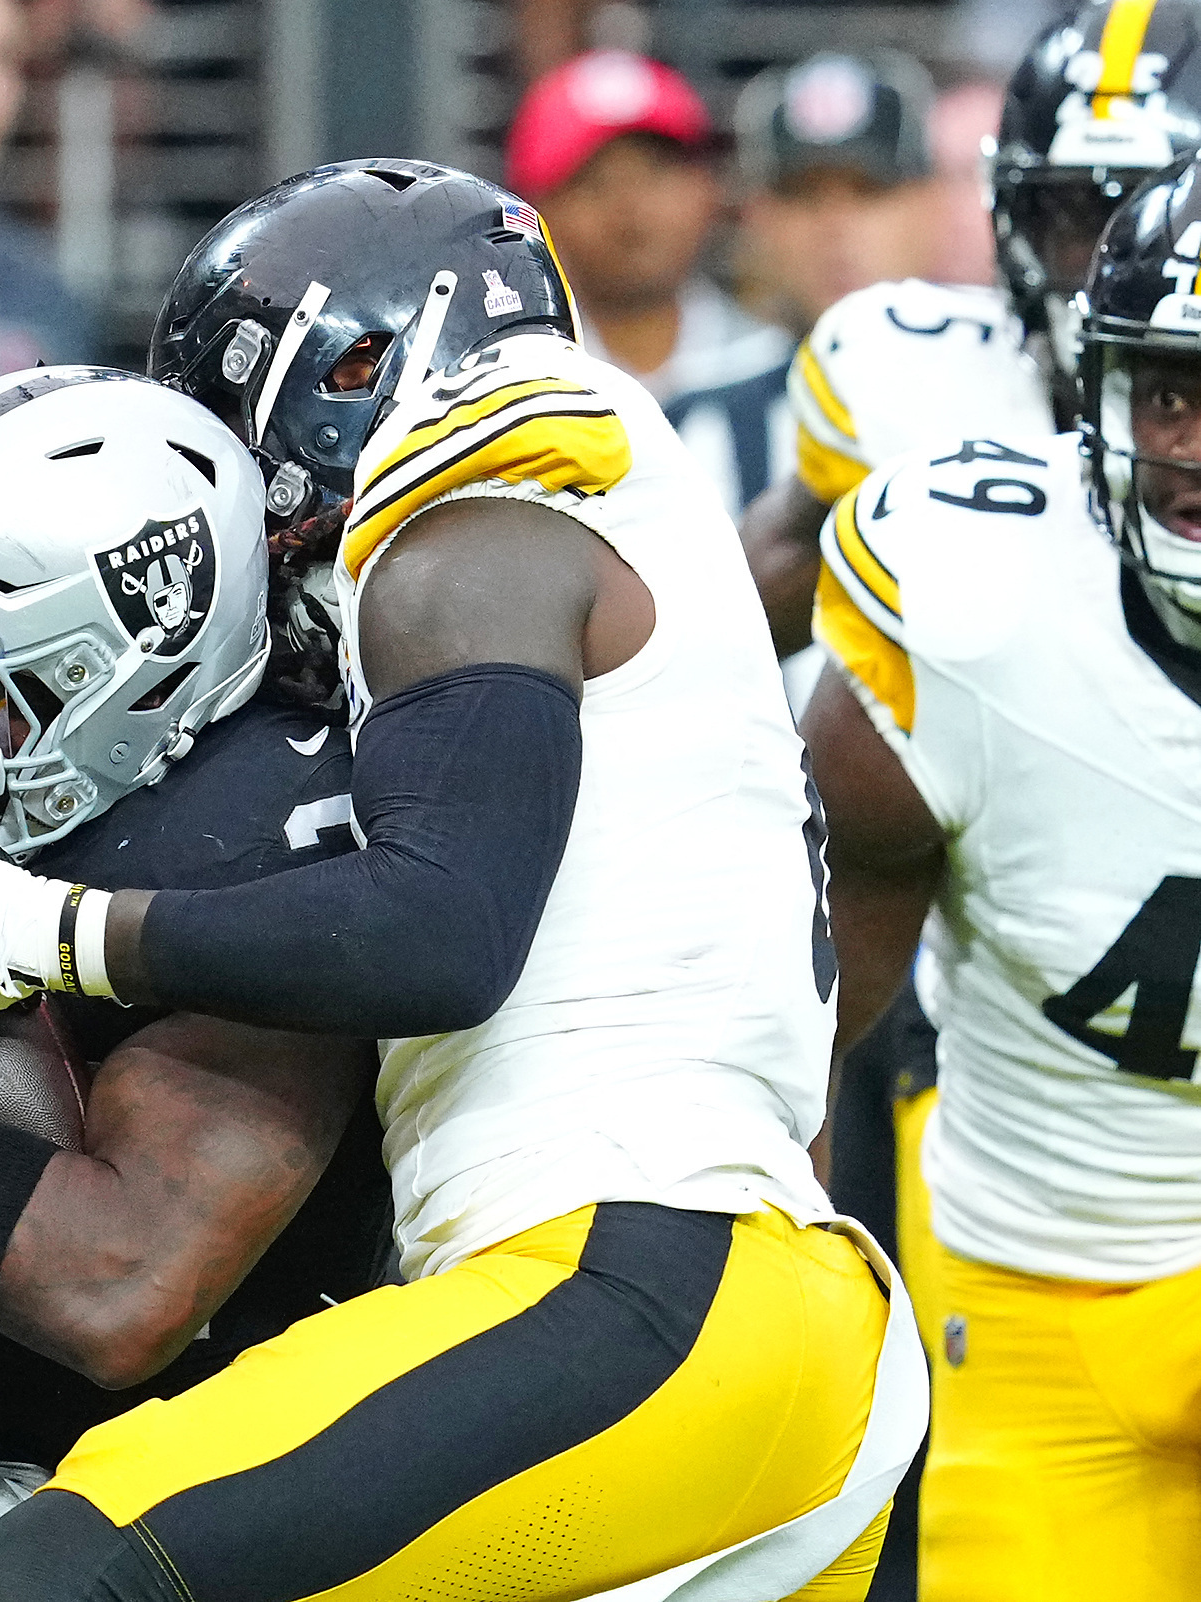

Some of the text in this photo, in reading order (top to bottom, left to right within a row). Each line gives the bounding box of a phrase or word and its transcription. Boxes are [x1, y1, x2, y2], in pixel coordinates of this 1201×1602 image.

[486, 293, 519, 310] CATCH
[929, 440, 1049, 517] 49
[108, 515, 200, 570] RAIDERS
[59, 942, 72, 971] GOD
[1041, 875, 1201, 1083] 4
